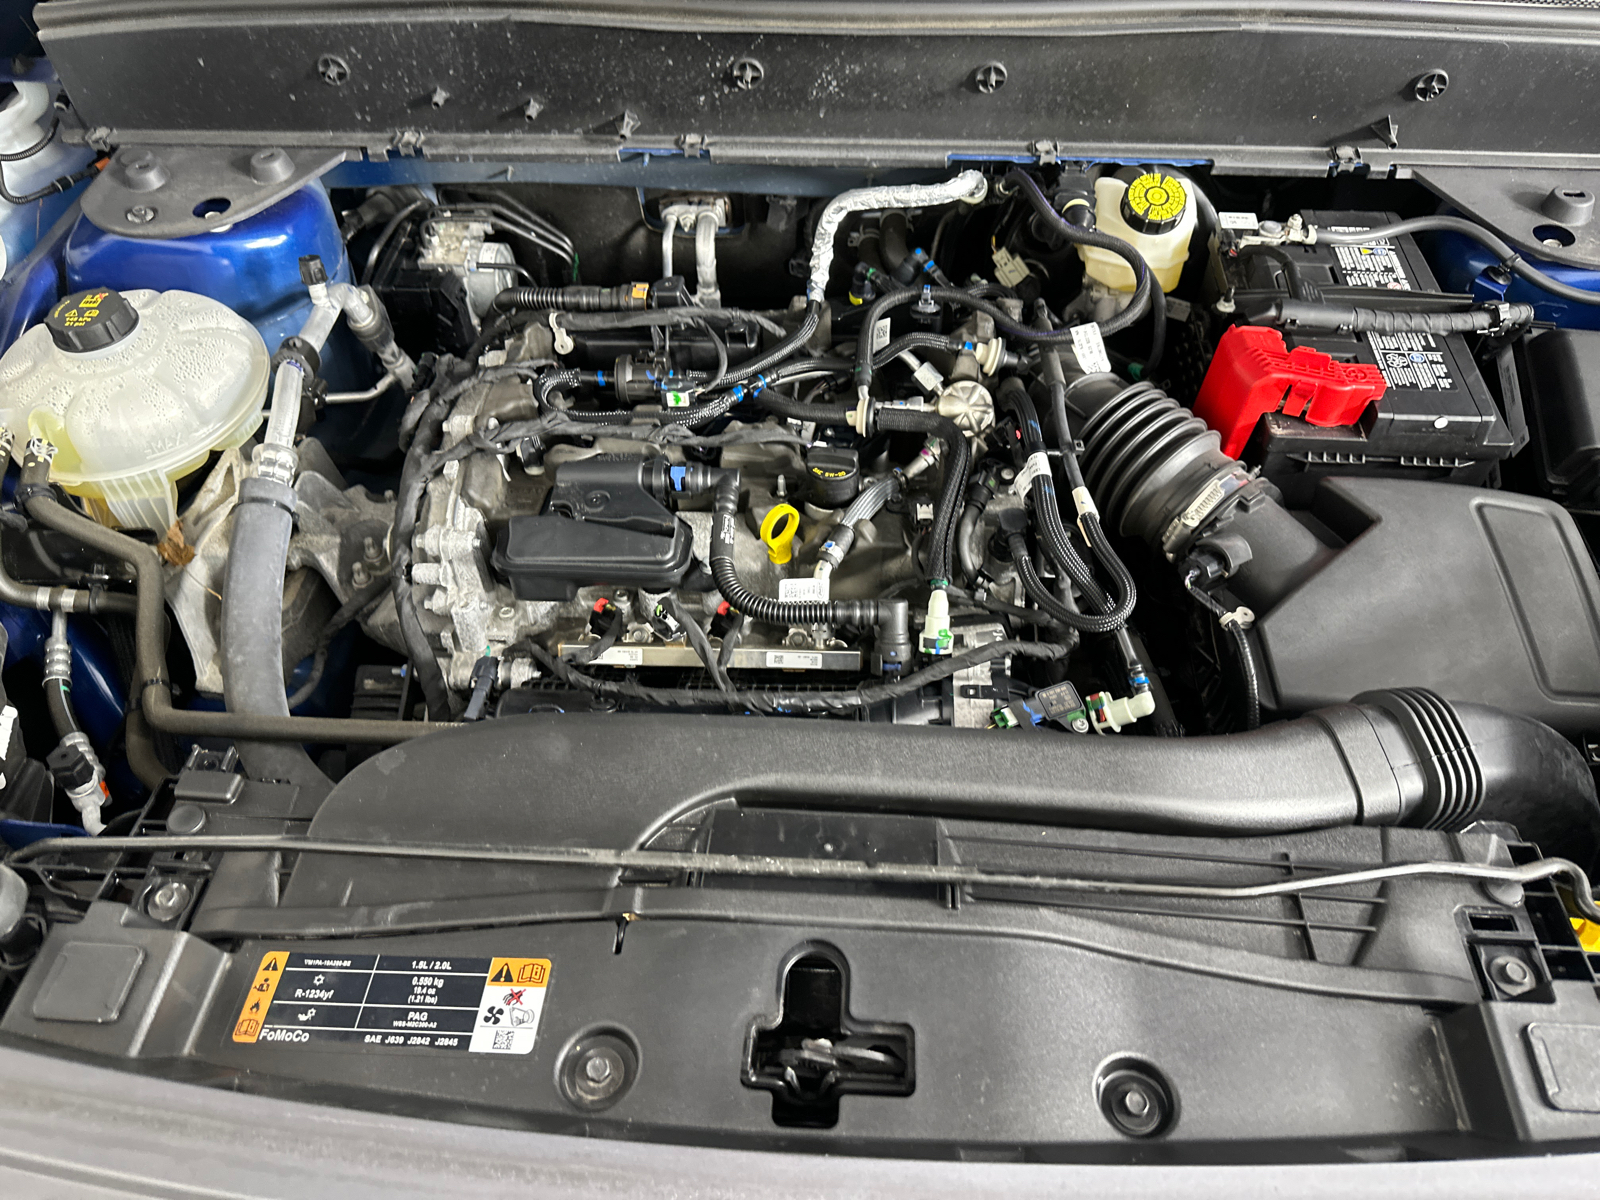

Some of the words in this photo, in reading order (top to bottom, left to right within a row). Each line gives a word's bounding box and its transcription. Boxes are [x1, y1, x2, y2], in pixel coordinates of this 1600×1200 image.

[434, 961, 452, 970] 2.0L
[412, 976, 433, 986] 0.550
[434, 977, 444, 988] kg
[294, 988, 334, 1000] R-1234yf
[408, 994, 424, 1004] (1.21
[424, 995, 438, 1004] lbs)
[407, 1012, 428, 1021] PAG
[259, 1028, 310, 1042] FoMoCo
[364, 1034, 382, 1044] SAE
[385, 1036, 404, 1044] J639
